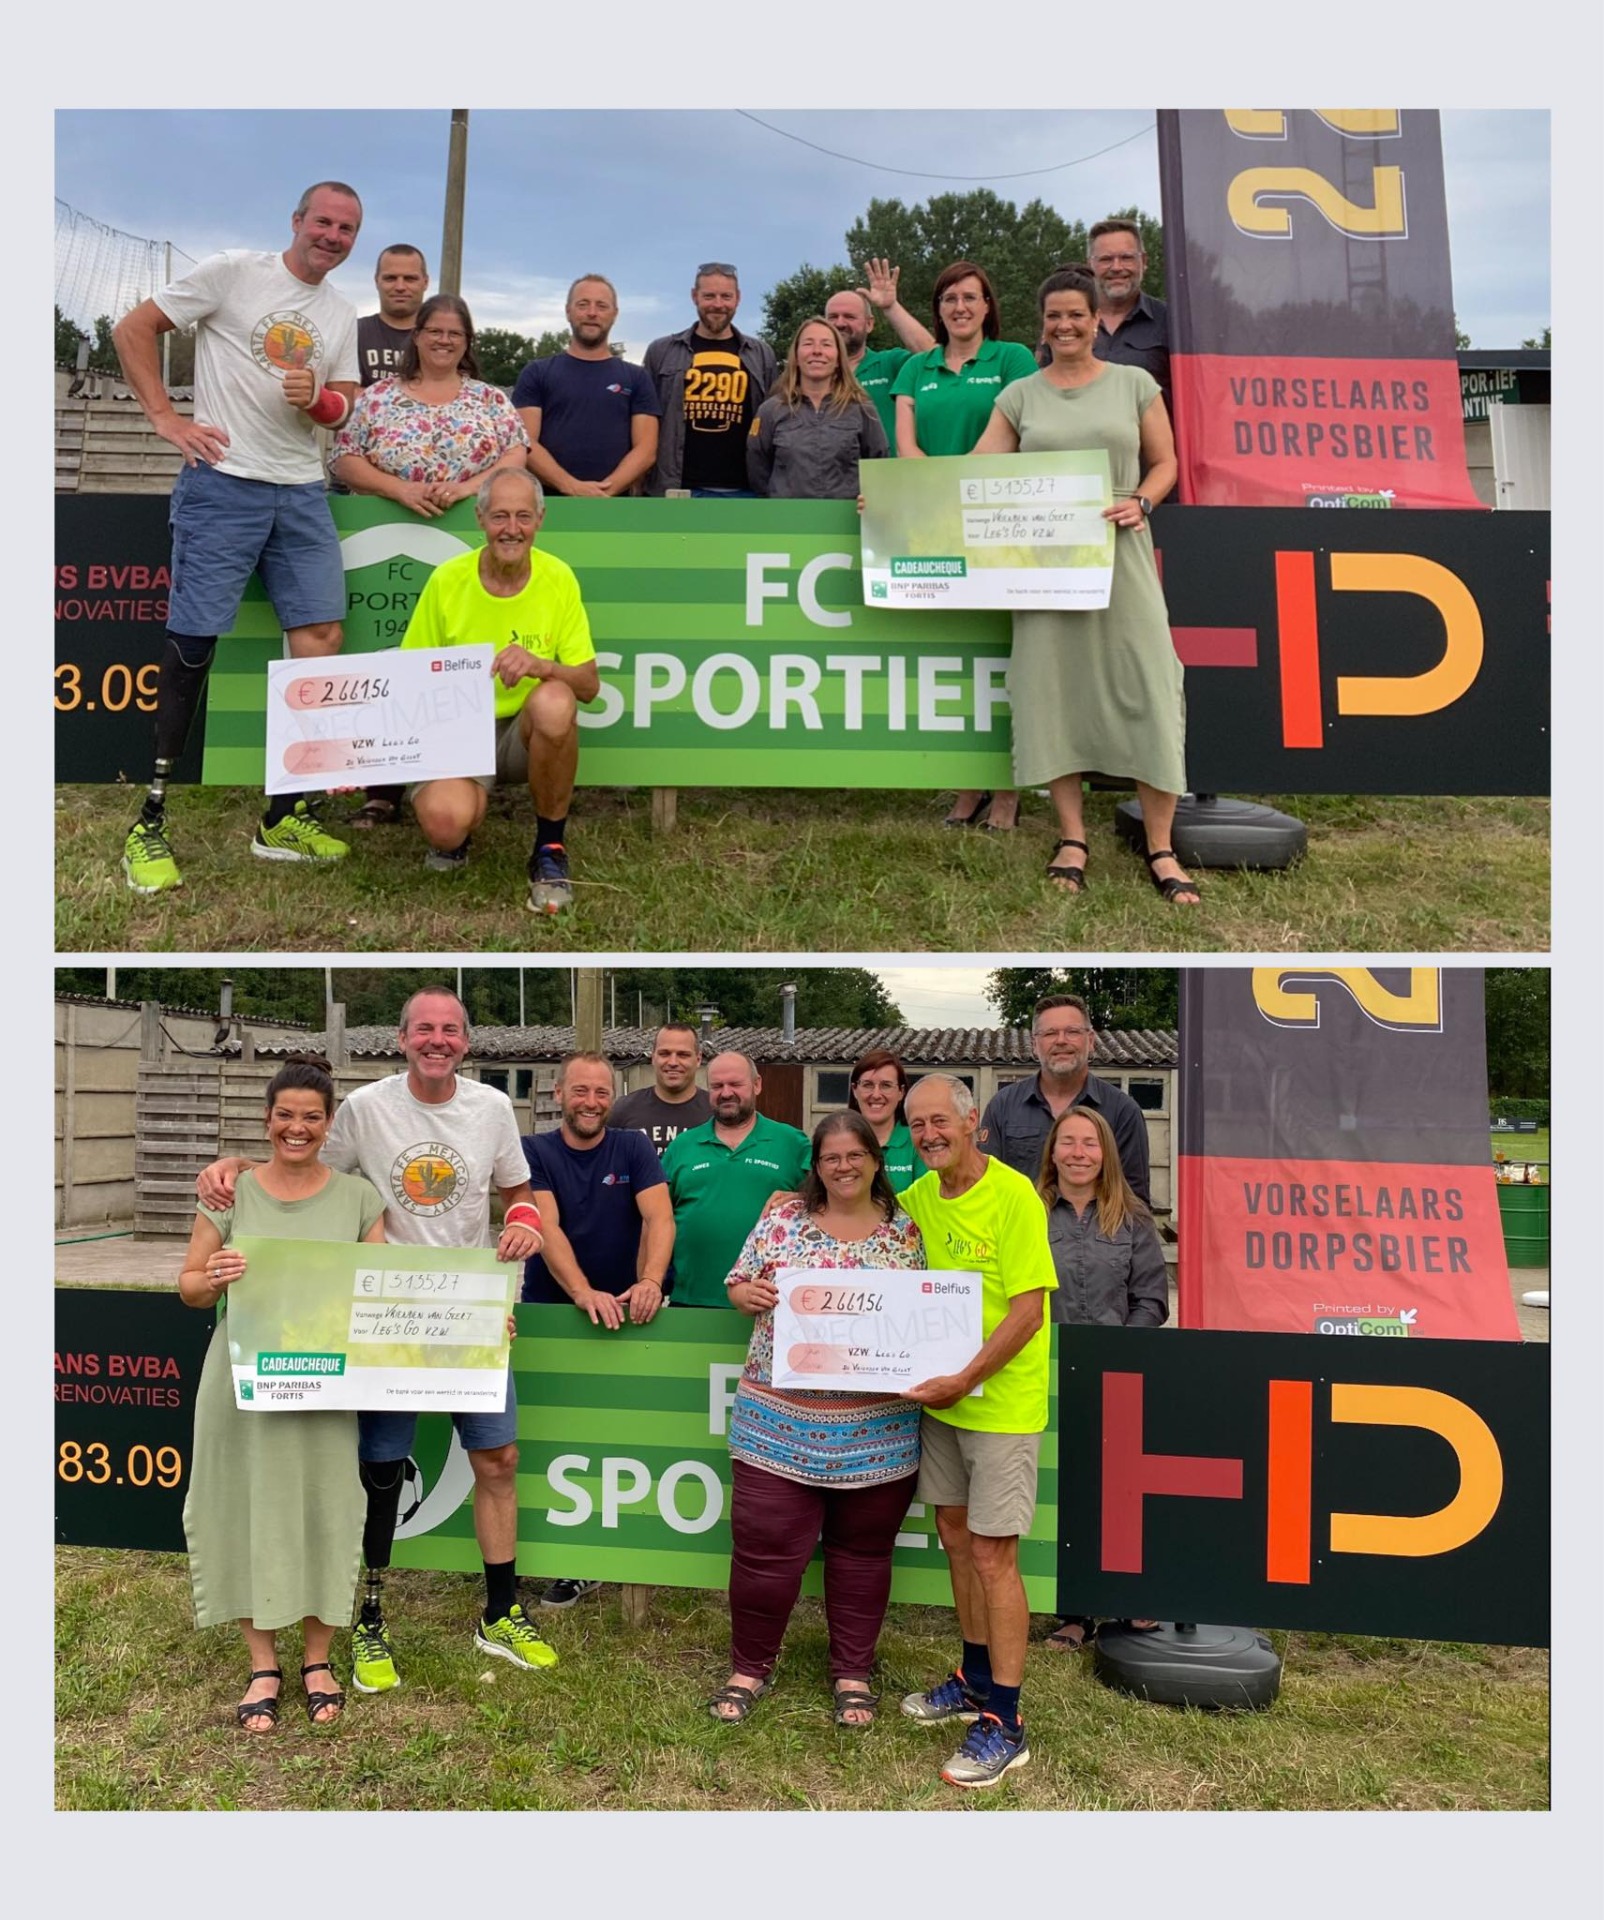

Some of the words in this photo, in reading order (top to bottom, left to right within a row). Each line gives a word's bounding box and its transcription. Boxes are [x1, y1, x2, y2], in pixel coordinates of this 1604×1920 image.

[685, 368, 748, 403] 2290
[1230, 376, 1430, 412] VORSELAARS
[1234, 420, 1436, 462] DORPSBIER
[87, 565, 171, 590] BVBA
[388, 562, 414, 581] FC
[894, 560, 963, 575] CADEAUCHEQUE
[744, 552, 854, 628] FC
[891, 581, 909, 591] BNP
[911, 581, 950, 591] PARIBAS
[905, 592, 936, 600] FORTIS
[444, 659, 482, 672] Belfius
[576, 652, 1011, 732] SPORTIEF
[396, 1152, 412, 1169] FE
[429, 1144, 467, 1187] MEXICO
[392, 1174, 418, 1212] SANTA
[433, 1191, 460, 1216] CITY
[1243, 1181, 1464, 1222] VORSELAARS
[1245, 1230, 1473, 1275] DORPSBIER
[934, 1283, 971, 1295] Belfius
[1313, 1303, 1371, 1314] Printed
[1376, 1304, 1395, 1314] by
[1319, 1321, 1405, 1336] OptiCom
[108, 1355, 181, 1379] BVBA
[261, 1356, 342, 1373] CADEAUCHEQUE
[256, 1381, 277, 1390] BNP
[278, 1381, 322, 1390] PARIBAS
[271, 1391, 304, 1401] FORTIS
[58, 1441, 182, 1488] 83.09
